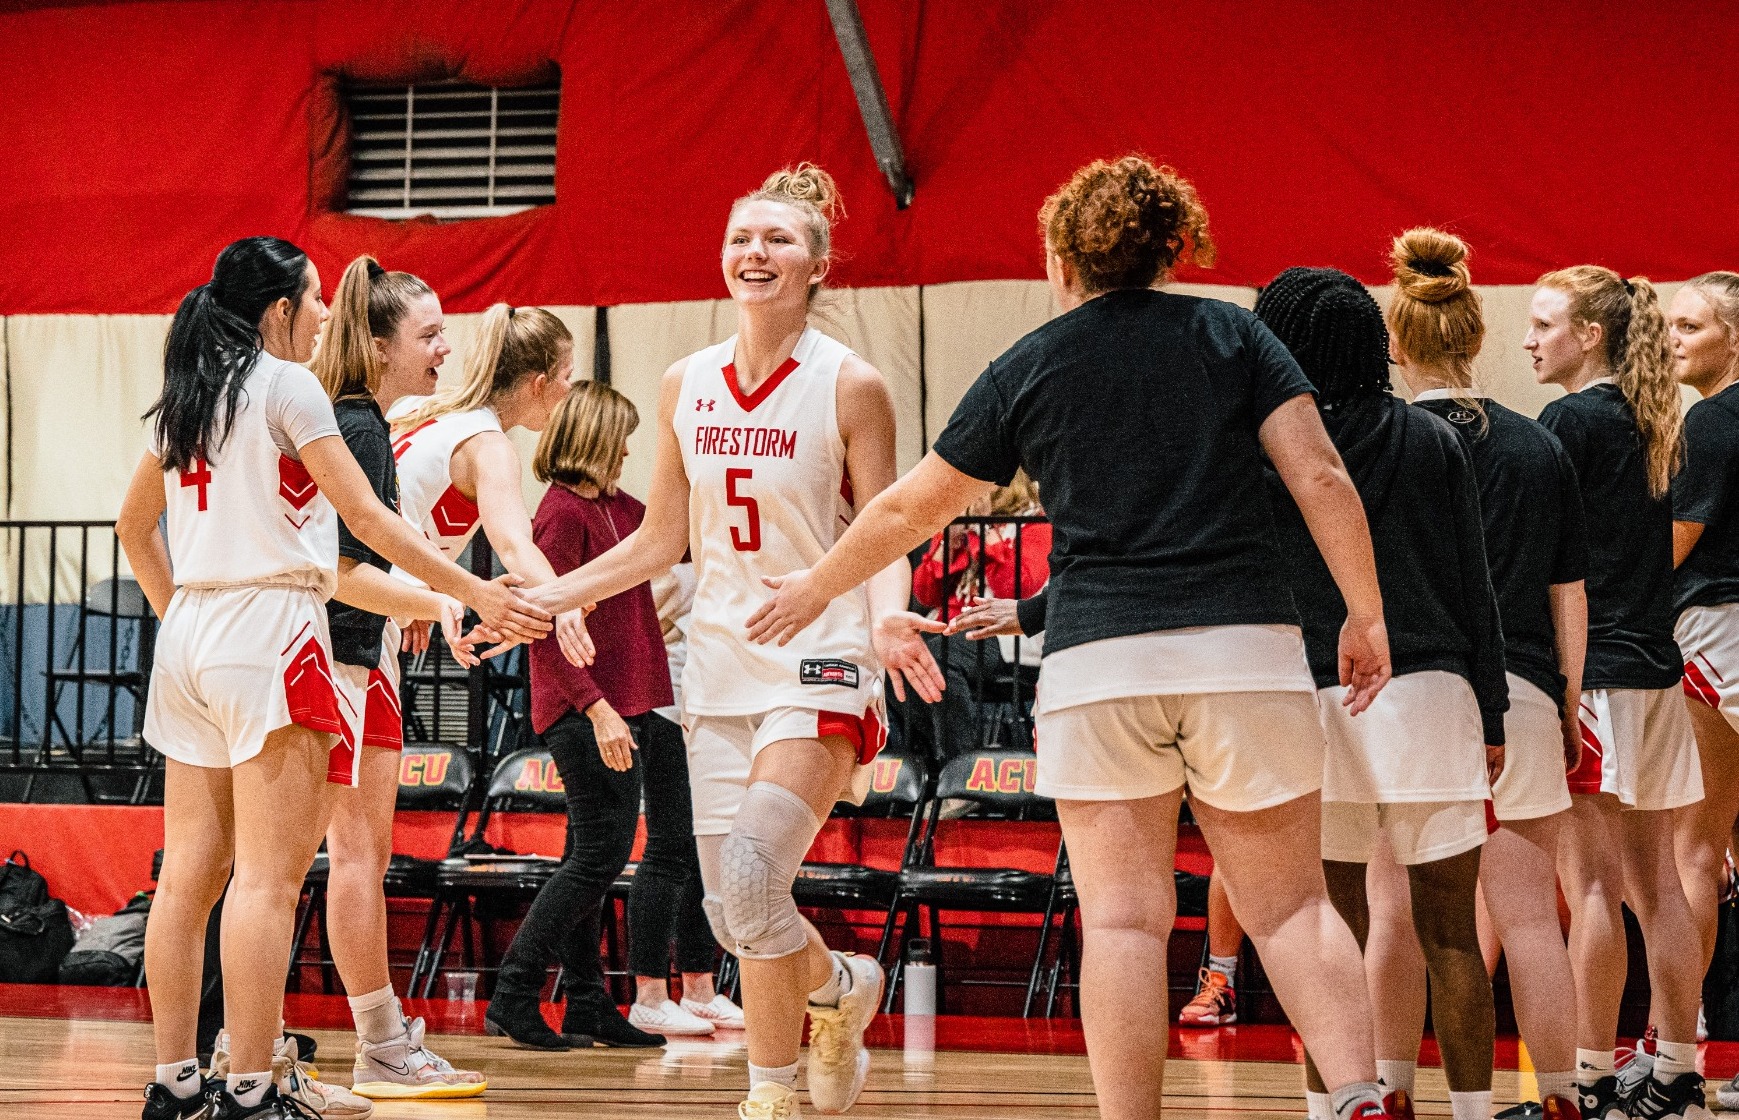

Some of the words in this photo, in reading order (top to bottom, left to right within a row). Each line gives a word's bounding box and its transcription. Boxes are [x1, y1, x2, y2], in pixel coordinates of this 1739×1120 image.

[695, 426, 797, 459] FIRESTORM
[181, 444, 212, 512] 4
[726, 467, 761, 551] 5
[399, 752, 451, 787] CU
[515, 758, 567, 793] AC
[181, 1064, 196, 1074] NIKE
[239, 1079, 258, 1088] NIKE
